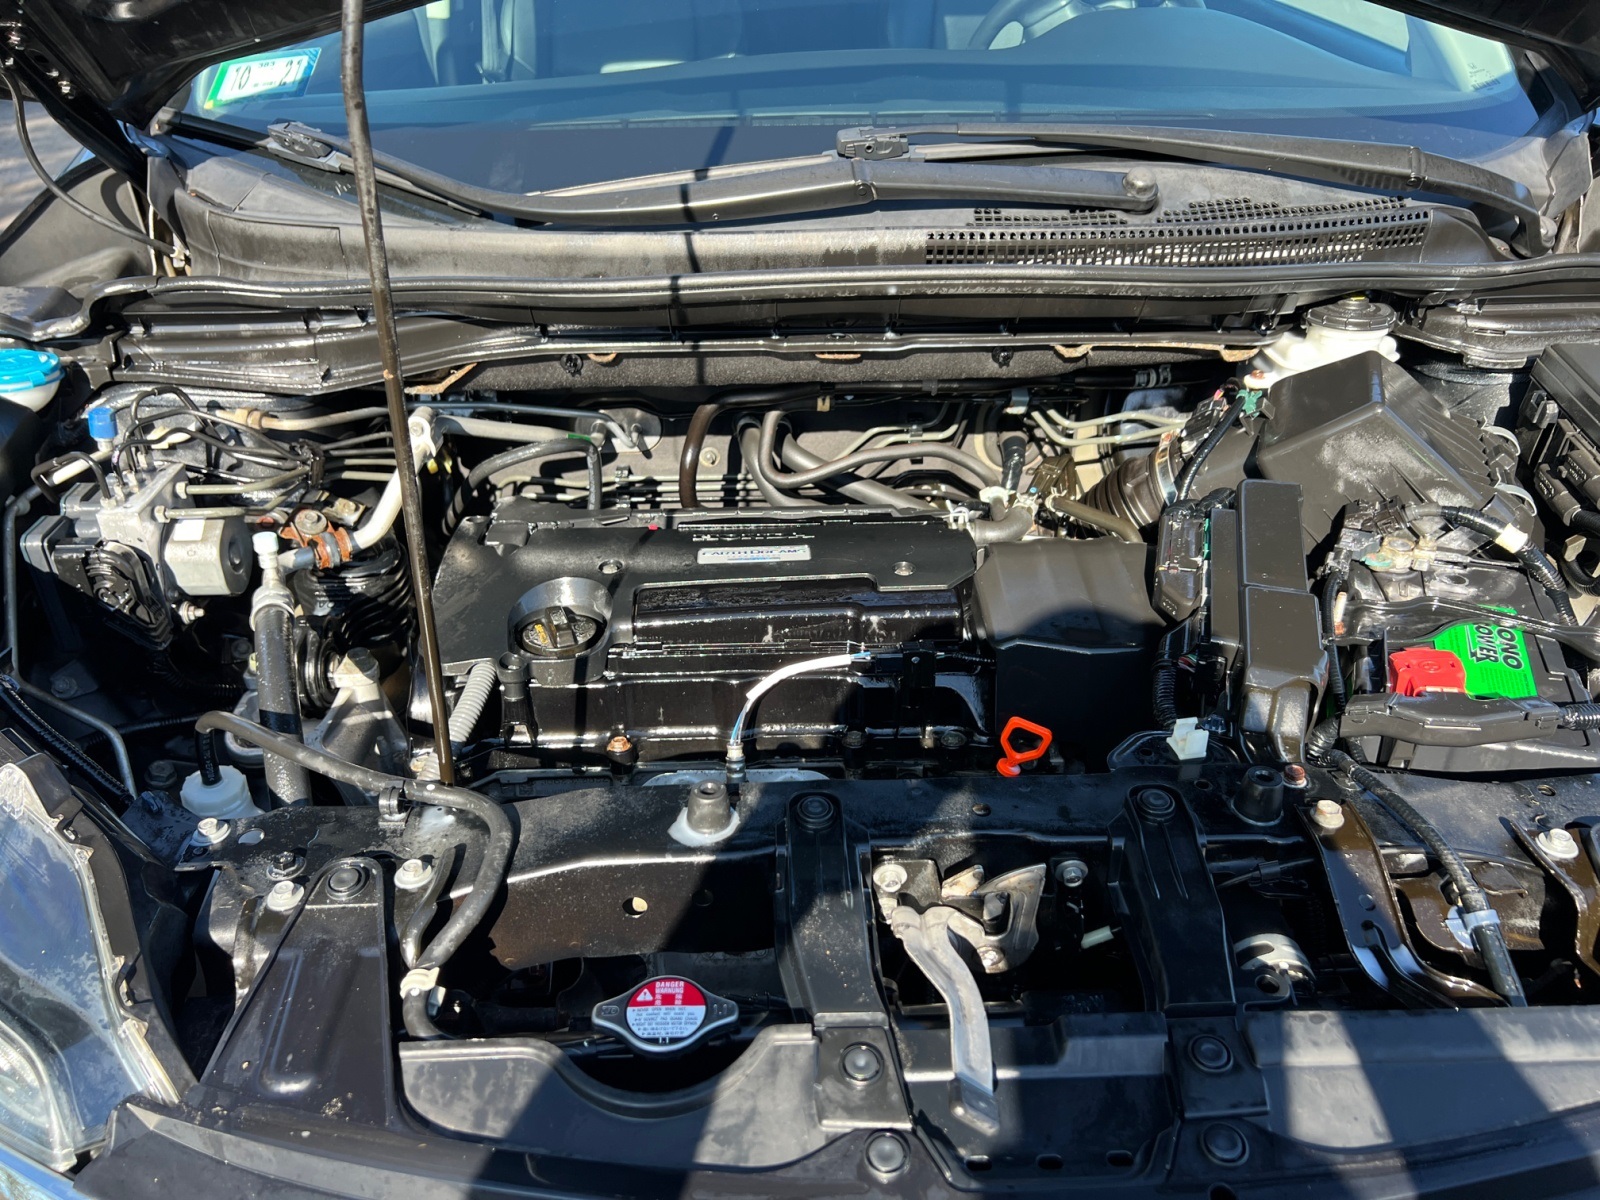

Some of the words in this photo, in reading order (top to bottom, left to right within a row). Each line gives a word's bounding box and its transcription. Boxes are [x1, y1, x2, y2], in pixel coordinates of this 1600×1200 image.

[231, 65, 252, 90] 10
[1473, 624, 1501, 664] OWER
[1495, 626, 1525, 670] ONO
